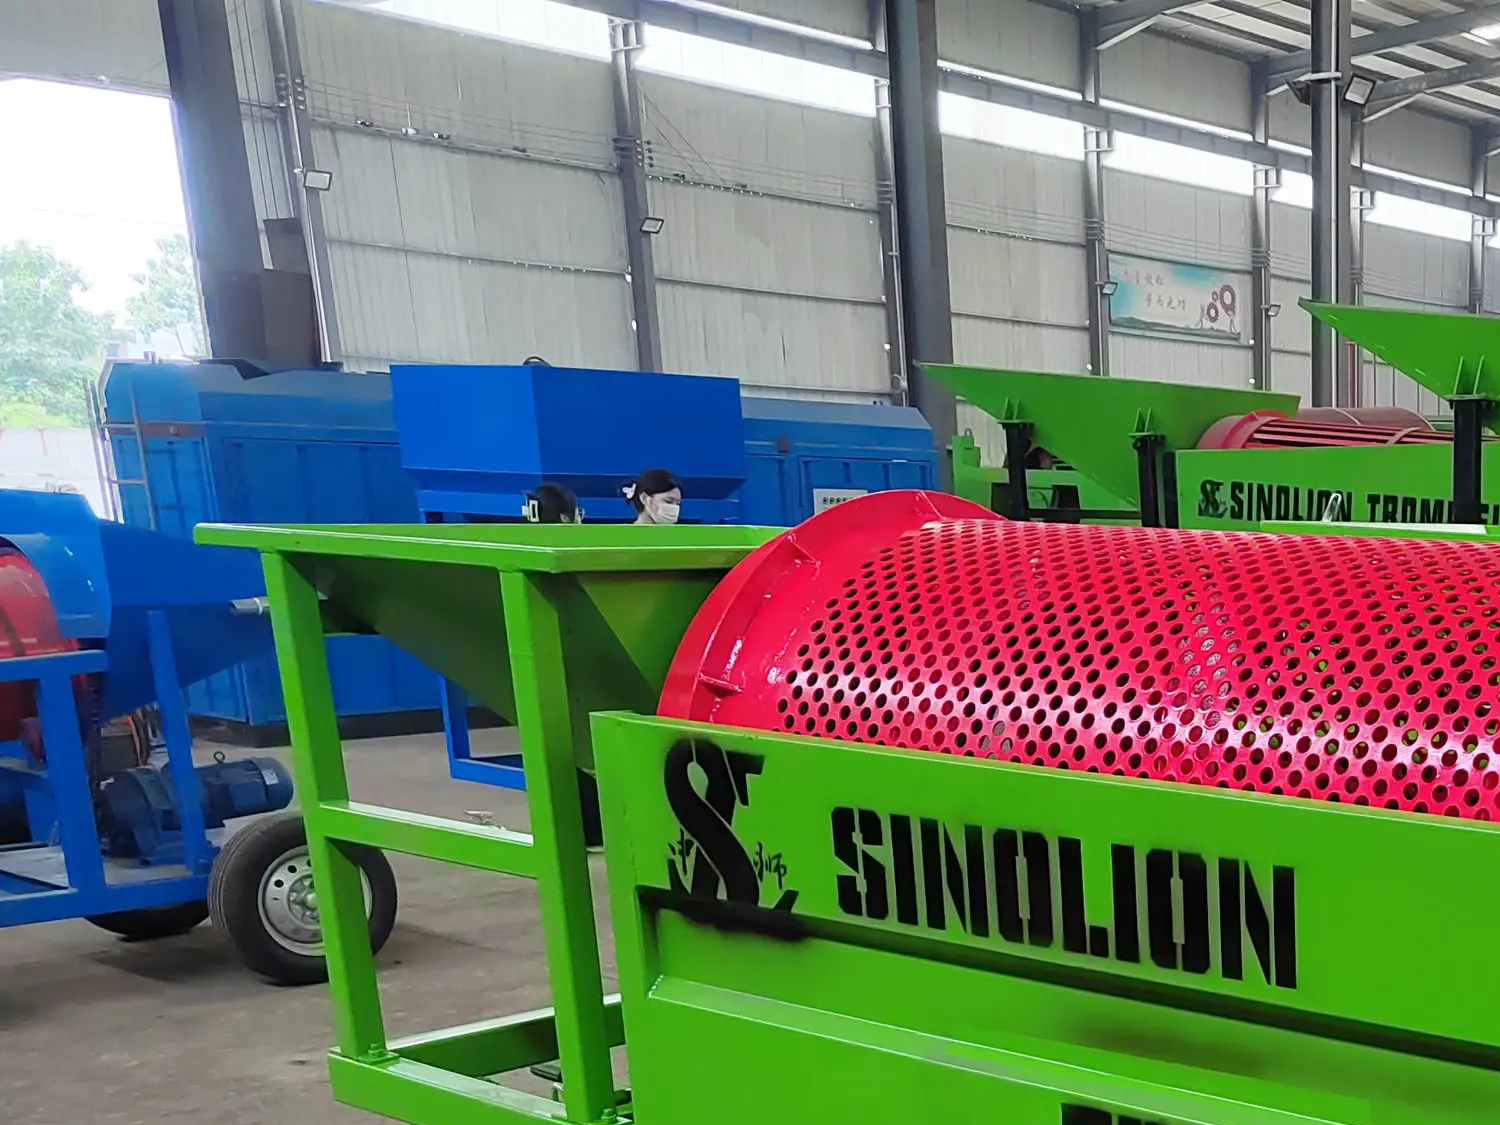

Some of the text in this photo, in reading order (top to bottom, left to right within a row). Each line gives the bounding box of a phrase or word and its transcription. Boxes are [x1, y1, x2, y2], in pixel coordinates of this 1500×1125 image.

[1229, 481, 1500, 526] SINOLION TROML
[831, 806, 1298, 990] SINOLION
